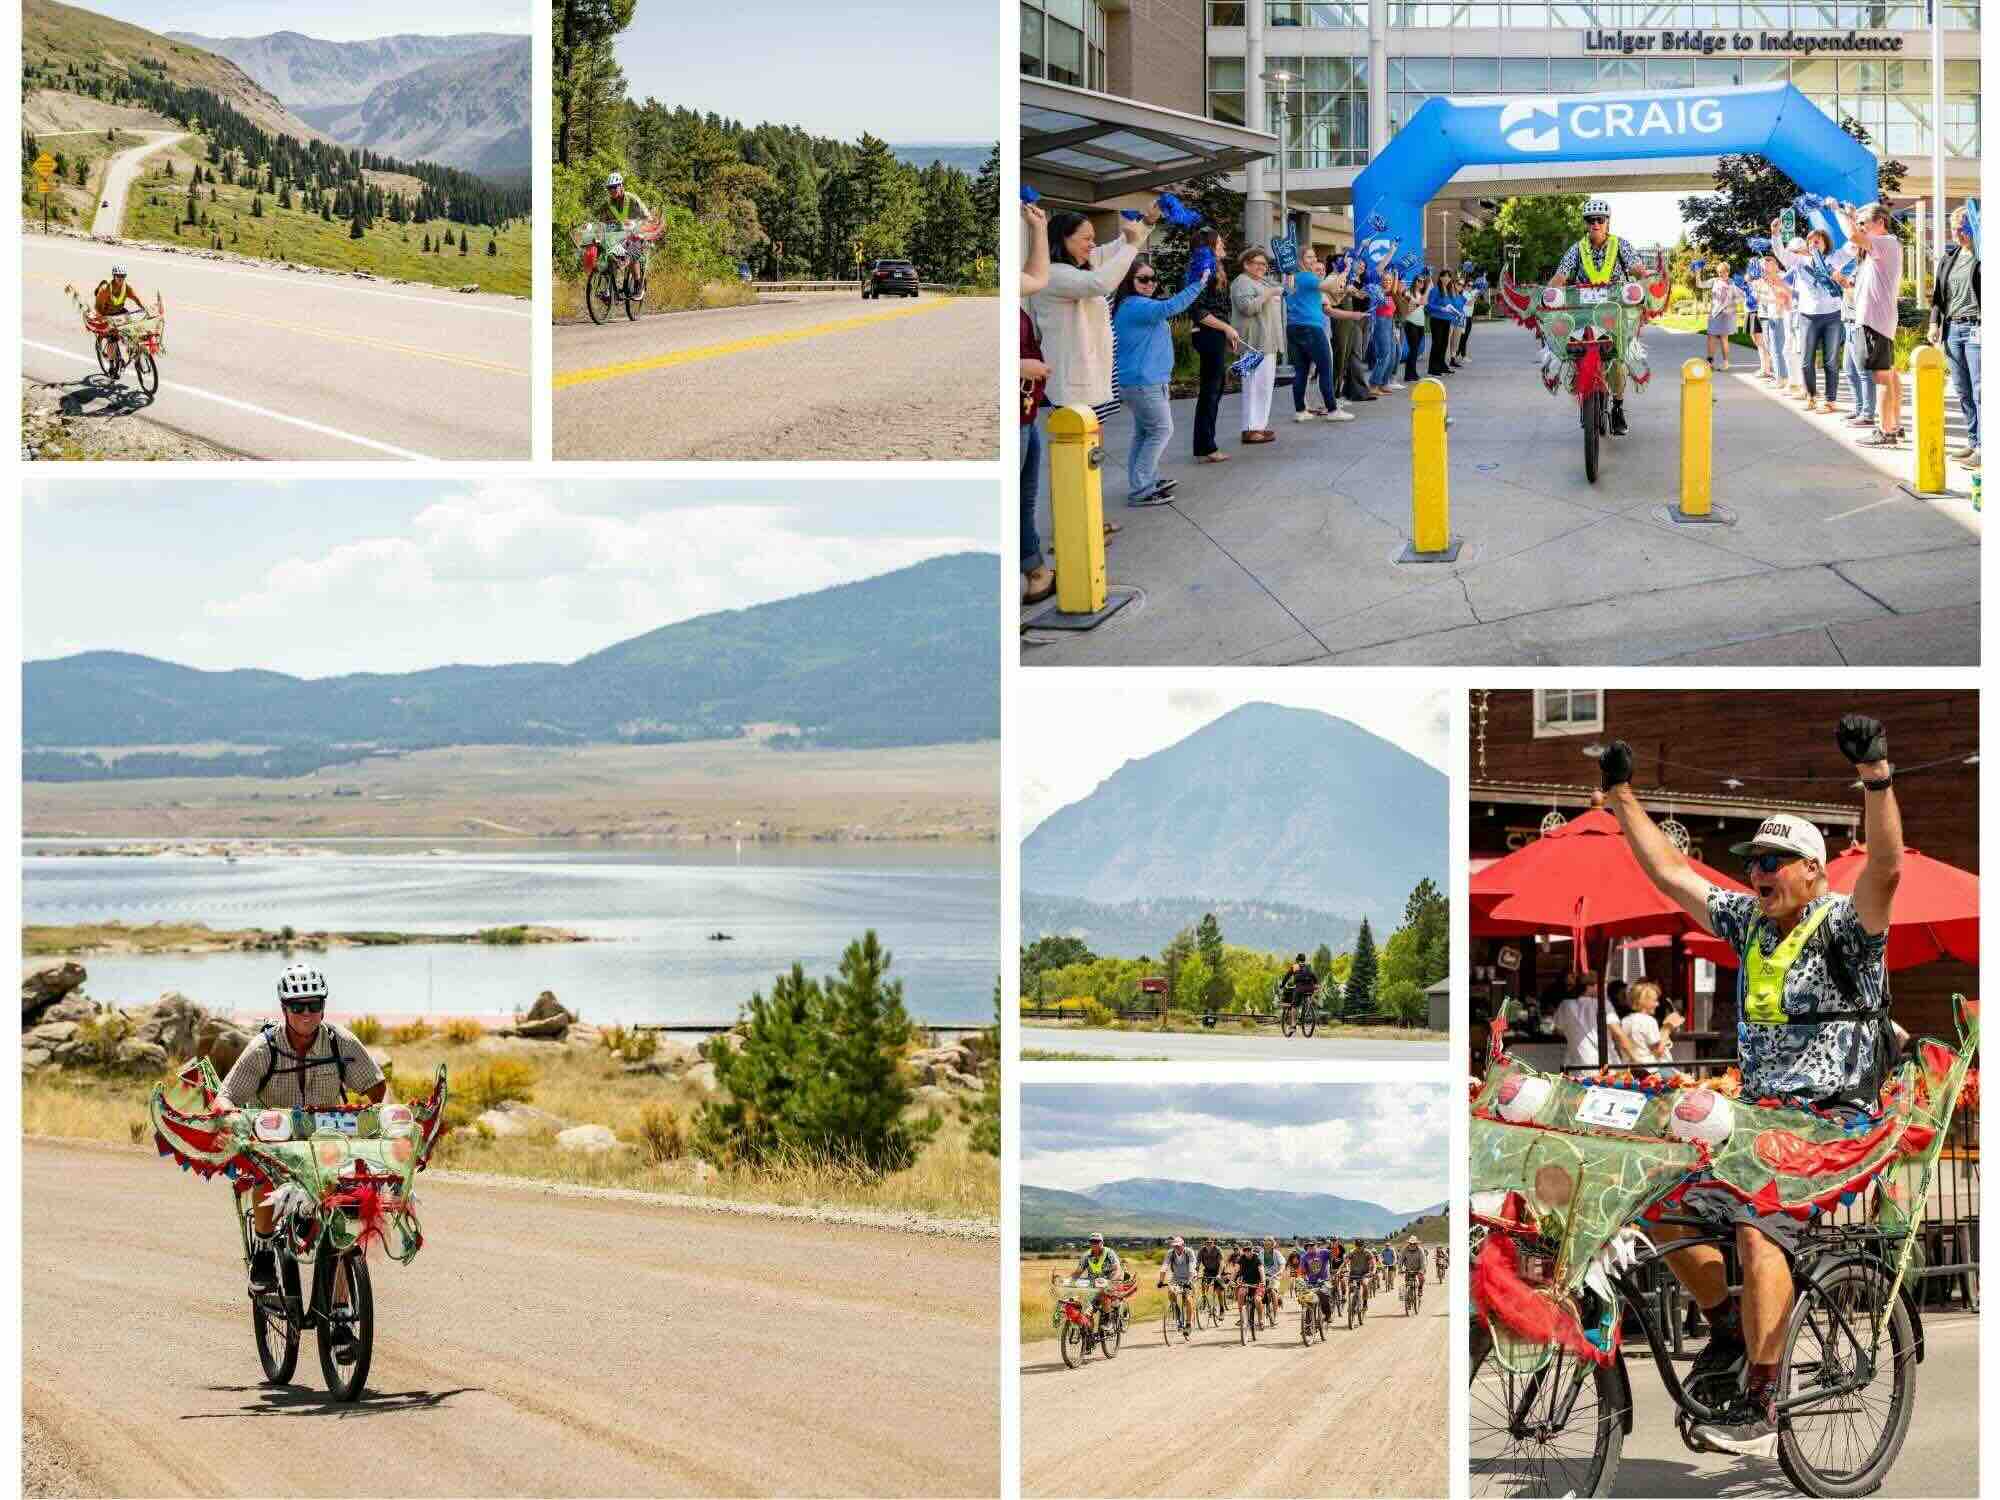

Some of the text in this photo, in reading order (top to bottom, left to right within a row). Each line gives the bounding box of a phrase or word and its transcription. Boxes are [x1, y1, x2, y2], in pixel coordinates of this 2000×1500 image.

[1586, 31, 1904, 54] Liniger Bridge to Independence
[1569, 99, 1724, 139] CRAIG
[1604, 1102, 1616, 1116] 1
